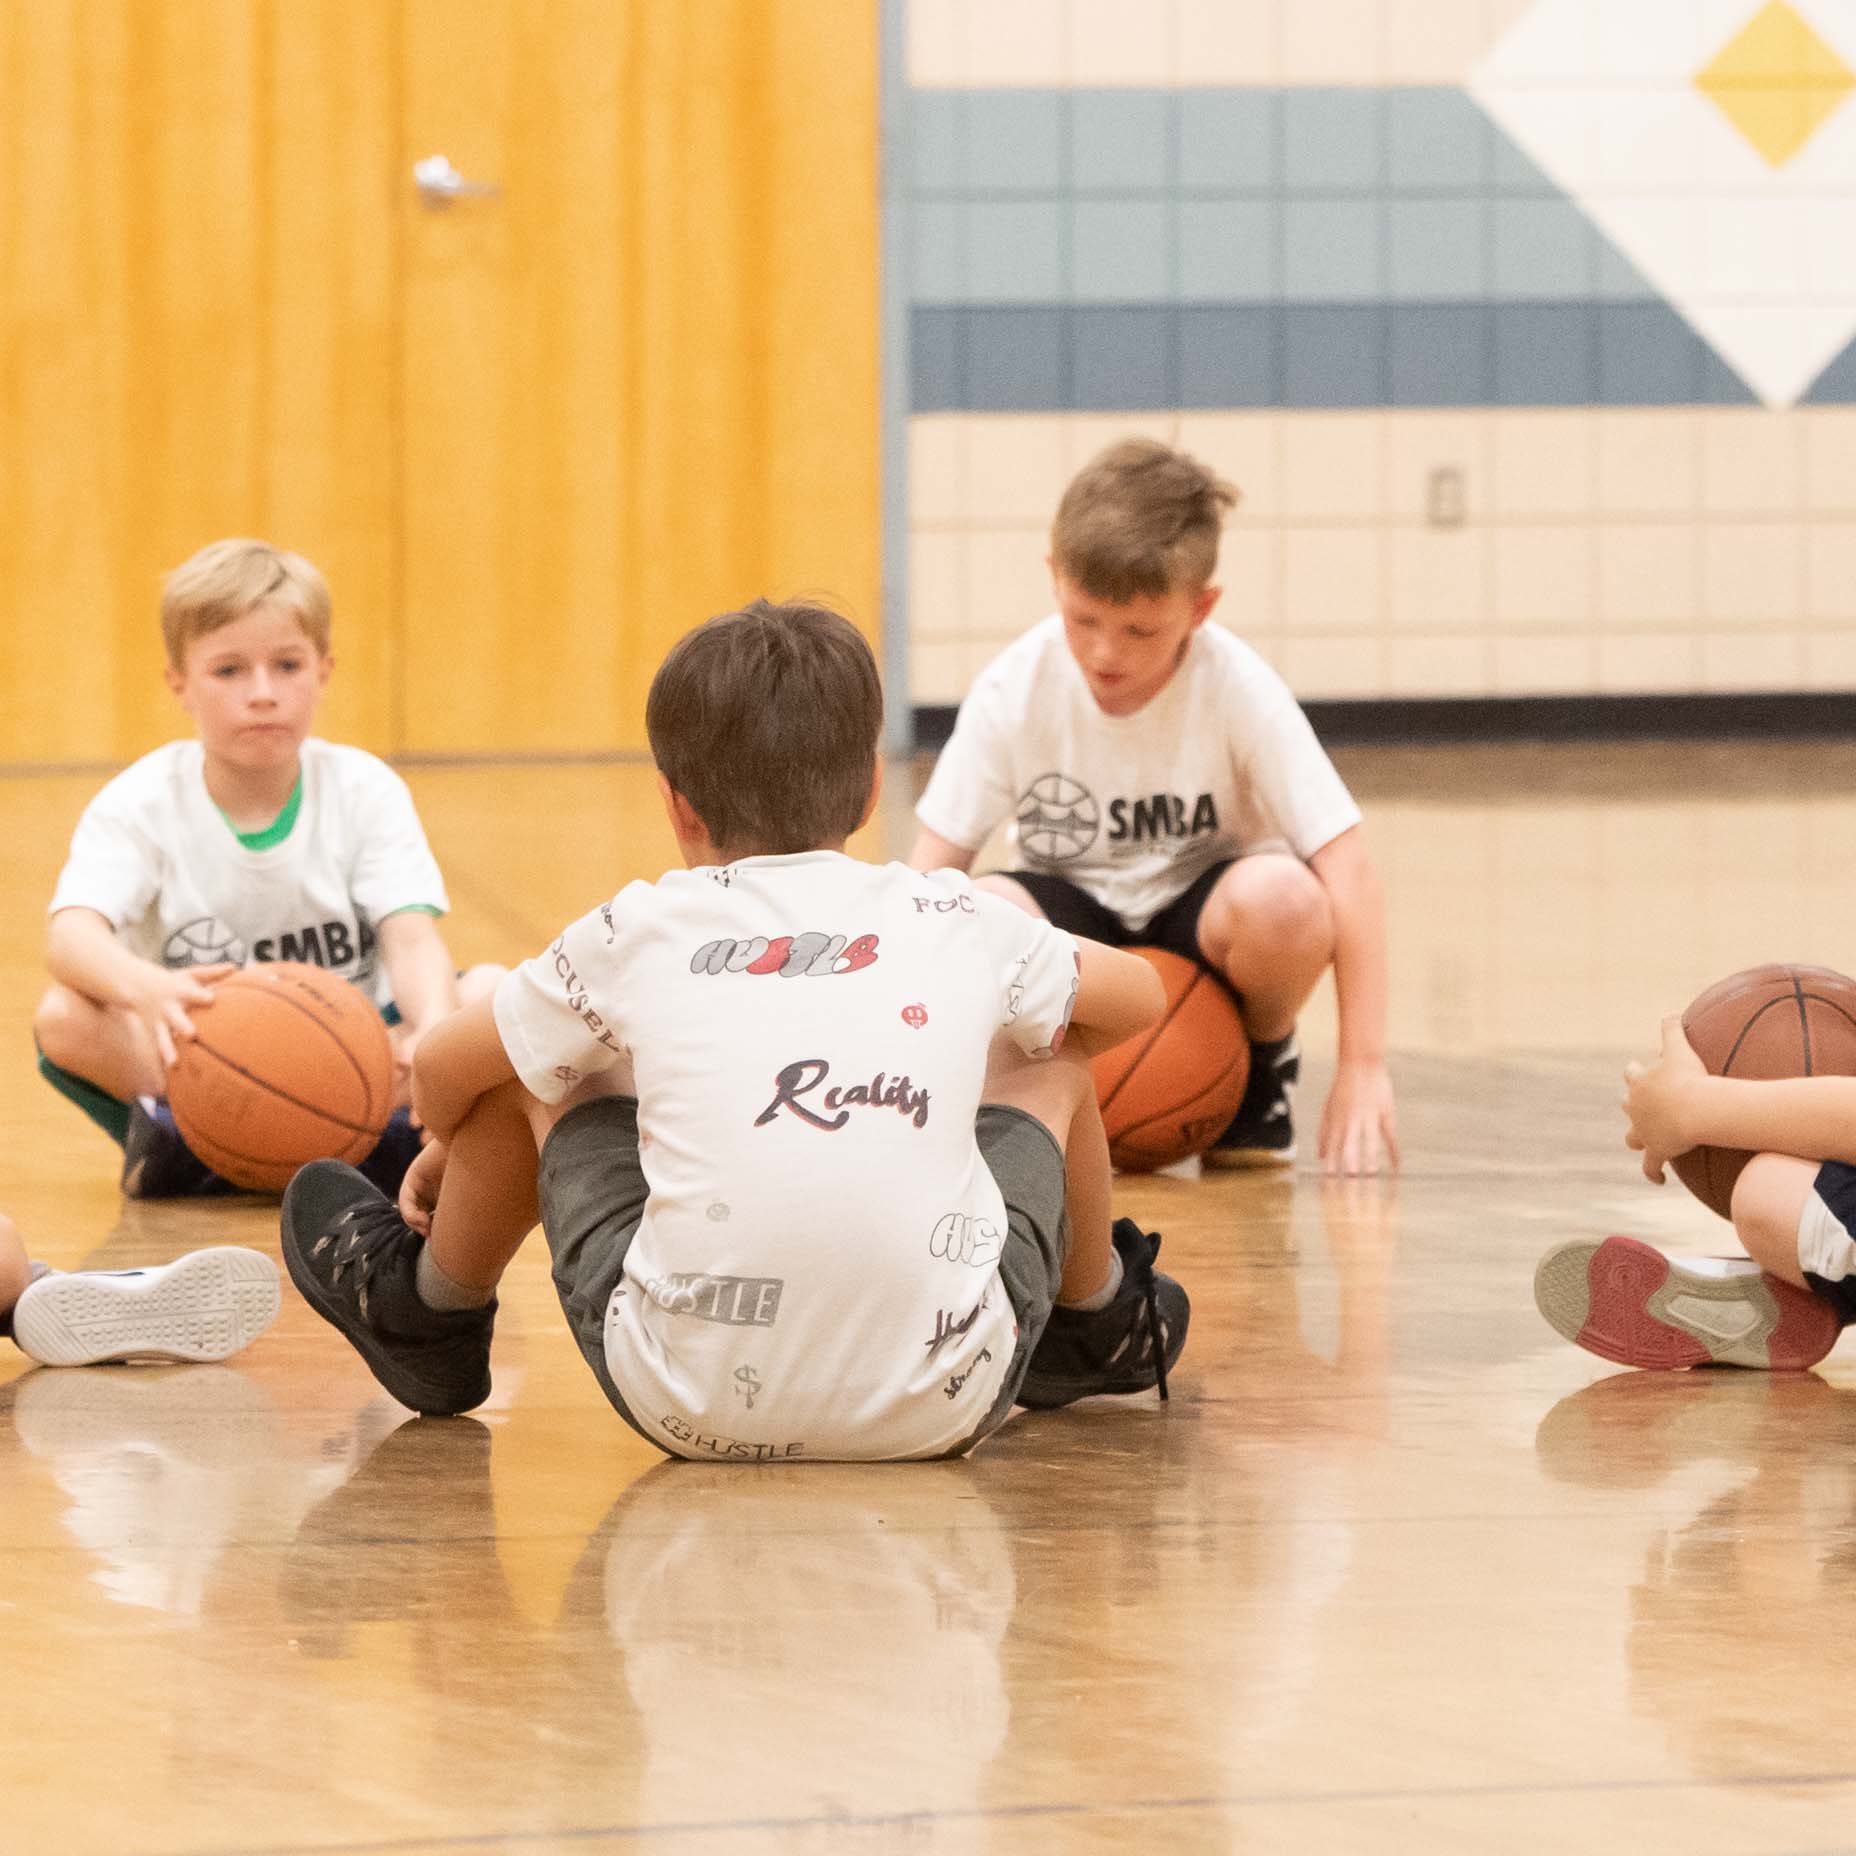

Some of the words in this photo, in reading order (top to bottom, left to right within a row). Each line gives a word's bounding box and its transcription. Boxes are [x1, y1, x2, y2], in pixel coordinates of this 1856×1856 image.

[1108, 793, 1217, 842] SMBA
[753, 1058, 932, 1133] Reality
[695, 1434, 804, 1459] HUSTLE
